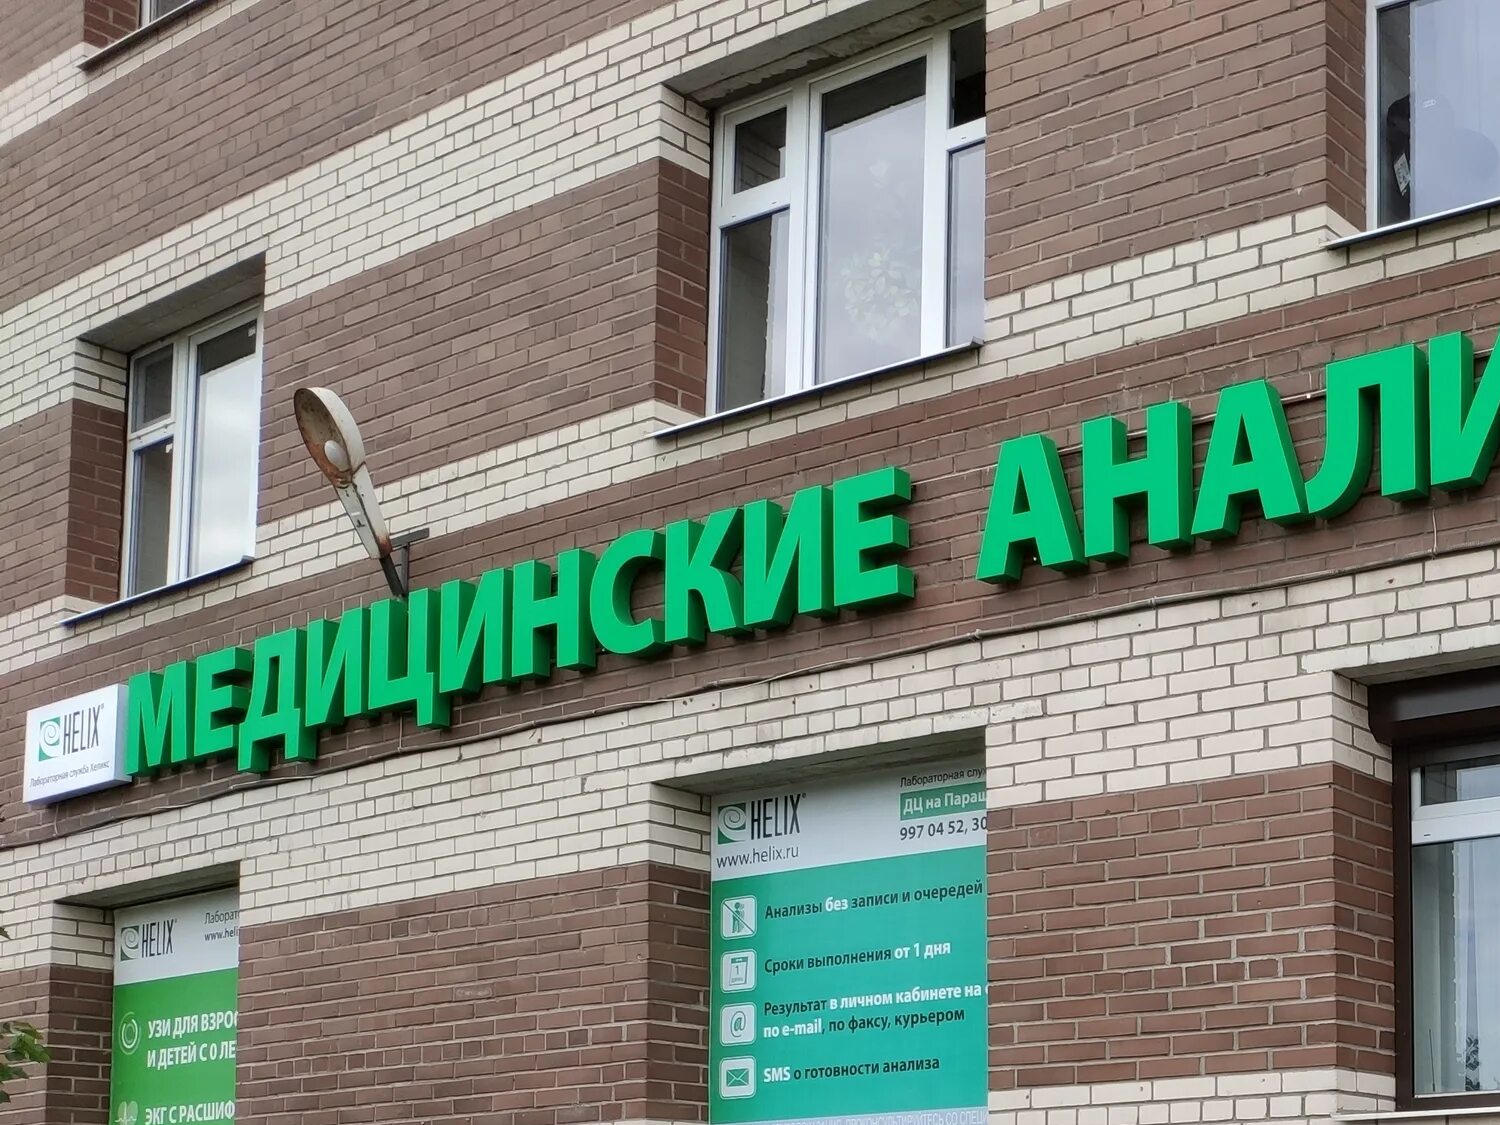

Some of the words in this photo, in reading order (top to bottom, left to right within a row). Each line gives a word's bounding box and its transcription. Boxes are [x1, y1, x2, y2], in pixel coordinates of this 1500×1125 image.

[125, 466, 914, 776] МЕДИЦИНСКИЕ
[63, 705, 101, 755] HELIX
[900, 771, 964, 788] Лабораторная
[750, 793, 801, 840] HELIX
[903, 797, 923, 815] ДЦ
[926, 797, 941, 809] на
[900, 825, 924, 841] 997
[927, 822, 944, 837] 04
[948, 820, 968, 835] 52,
[716, 845, 799, 869] www.helix.ru
[765, 905, 822, 920] Анализы
[825, 896, 848, 912] без
[851, 893, 898, 908] записи
[902, 891, 910, 902] и
[914, 880, 983, 902] очередей
[142, 919, 174, 958] HELIX
[764, 958, 804, 976] Сроки
[807, 948, 891, 969] выполнения
[894, 947, 910, 959] от
[913, 943, 920, 957] 1
[923, 942, 951, 959] дня
[764, 999, 827, 1018] Результат
[829, 998, 838, 1010] в
[840, 992, 893, 1009] личном
[895, 986, 962, 1003] кабинете
[964, 984, 982, 997] на
[147, 1018, 171, 1039] УЗИ
[172, 1014, 198, 1039] ДЛЯ
[763, 1026, 780, 1038] по
[782, 1018, 825, 1036] e-mail,
[829, 1019, 845, 1033] по
[848, 1015, 891, 1034] факсу,
[894, 1009, 965, 1029] курьером
[147, 1049, 156, 1068] И
[157, 1041, 197, 1071] ДЕТЕЙ
[199, 1043, 208, 1061] С
[763, 1066, 791, 1083] SMS
[794, 1069, 801, 1080] о
[804, 1062, 880, 1080] готовности
[883, 1058, 940, 1073] анализа
[145, 1106, 167, 1125] ЭКГ
[168, 1106, 177, 1124] С
[945, 1111, 958, 1125] СО
